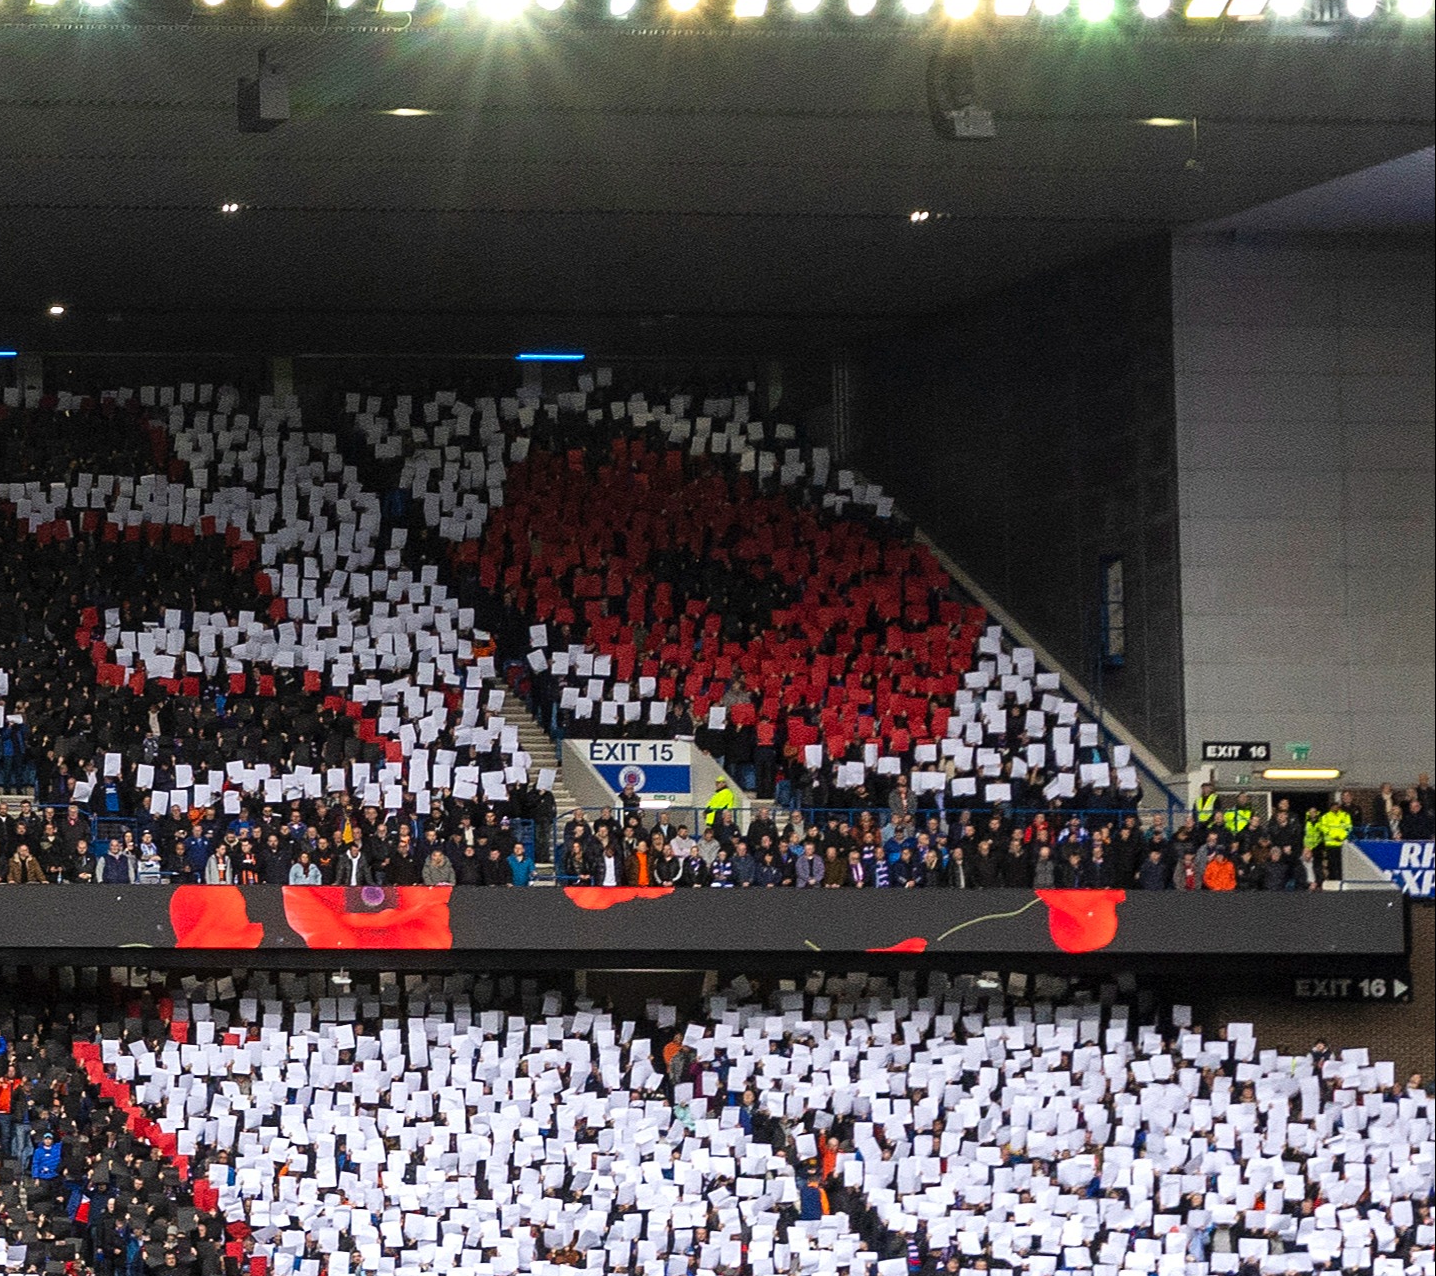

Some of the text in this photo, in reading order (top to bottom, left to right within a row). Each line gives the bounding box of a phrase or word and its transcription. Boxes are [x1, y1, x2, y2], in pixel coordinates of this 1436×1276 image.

[589, 742, 674, 761] EXIT 15
[1205, 745, 1267, 758] EXIT 16
[1294, 978, 1387, 998] EXIT 16
